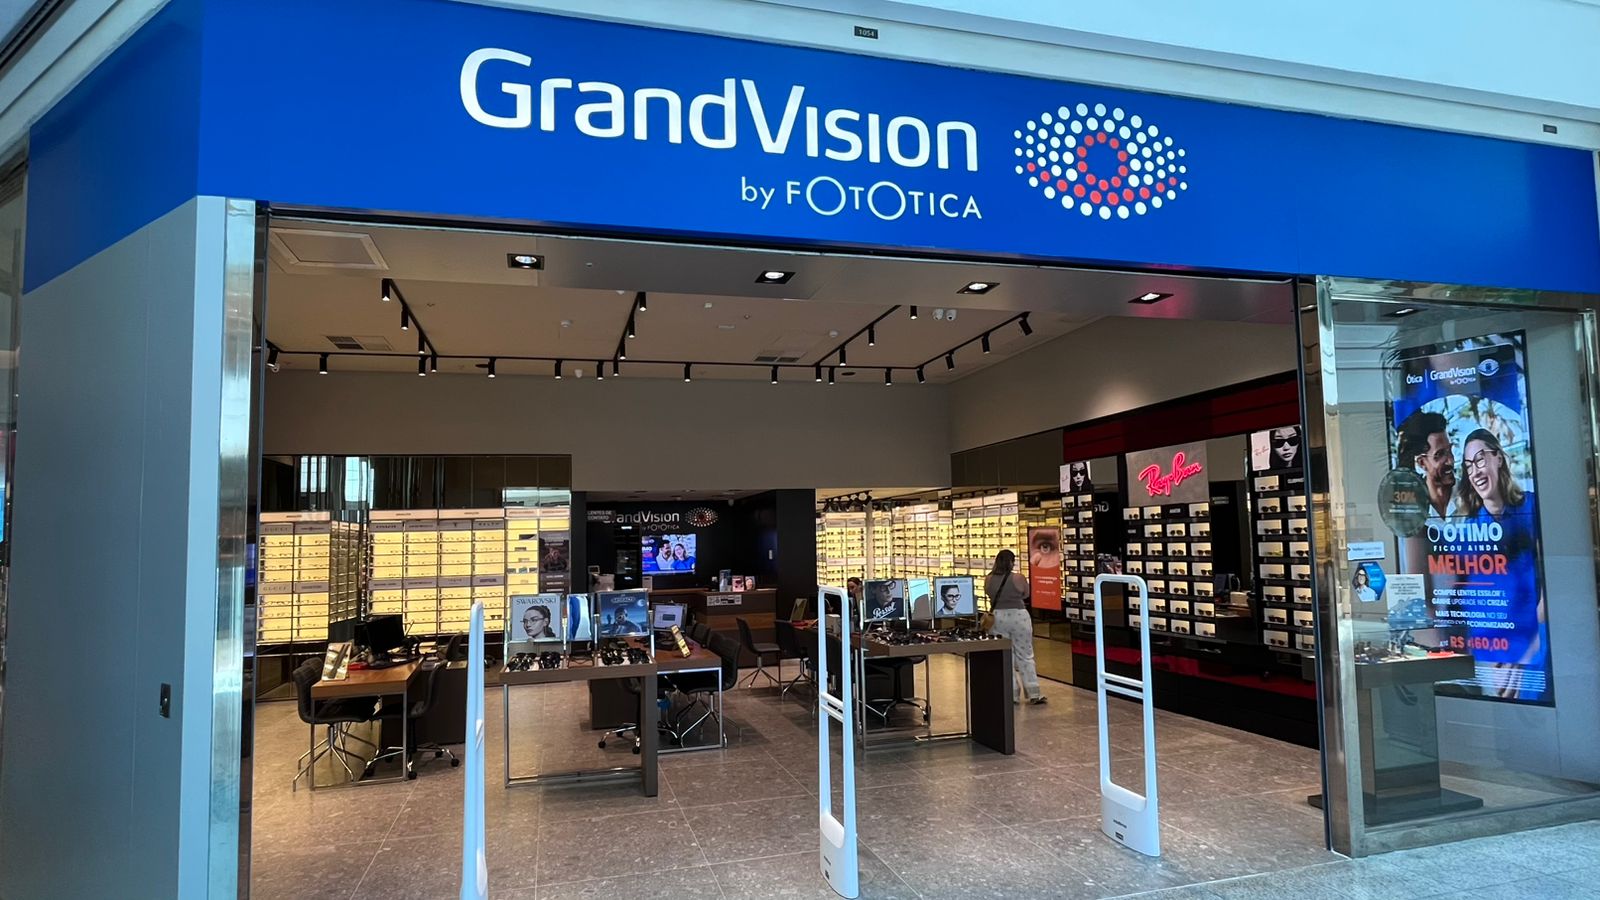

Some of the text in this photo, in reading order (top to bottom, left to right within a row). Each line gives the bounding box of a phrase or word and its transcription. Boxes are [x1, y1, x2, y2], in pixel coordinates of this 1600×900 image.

[459, 47, 979, 172] GrandVision
[741, 176, 982, 221] by FOTOTICA
[1430, 366, 1476, 380] GrandVision
[1443, 518, 1503, 542] ÓTIMO
[1468, 544, 1499, 552] AINDA
[1428, 554, 1508, 576] MELHOR
[516, 597, 557, 605] SWAROVSKI
